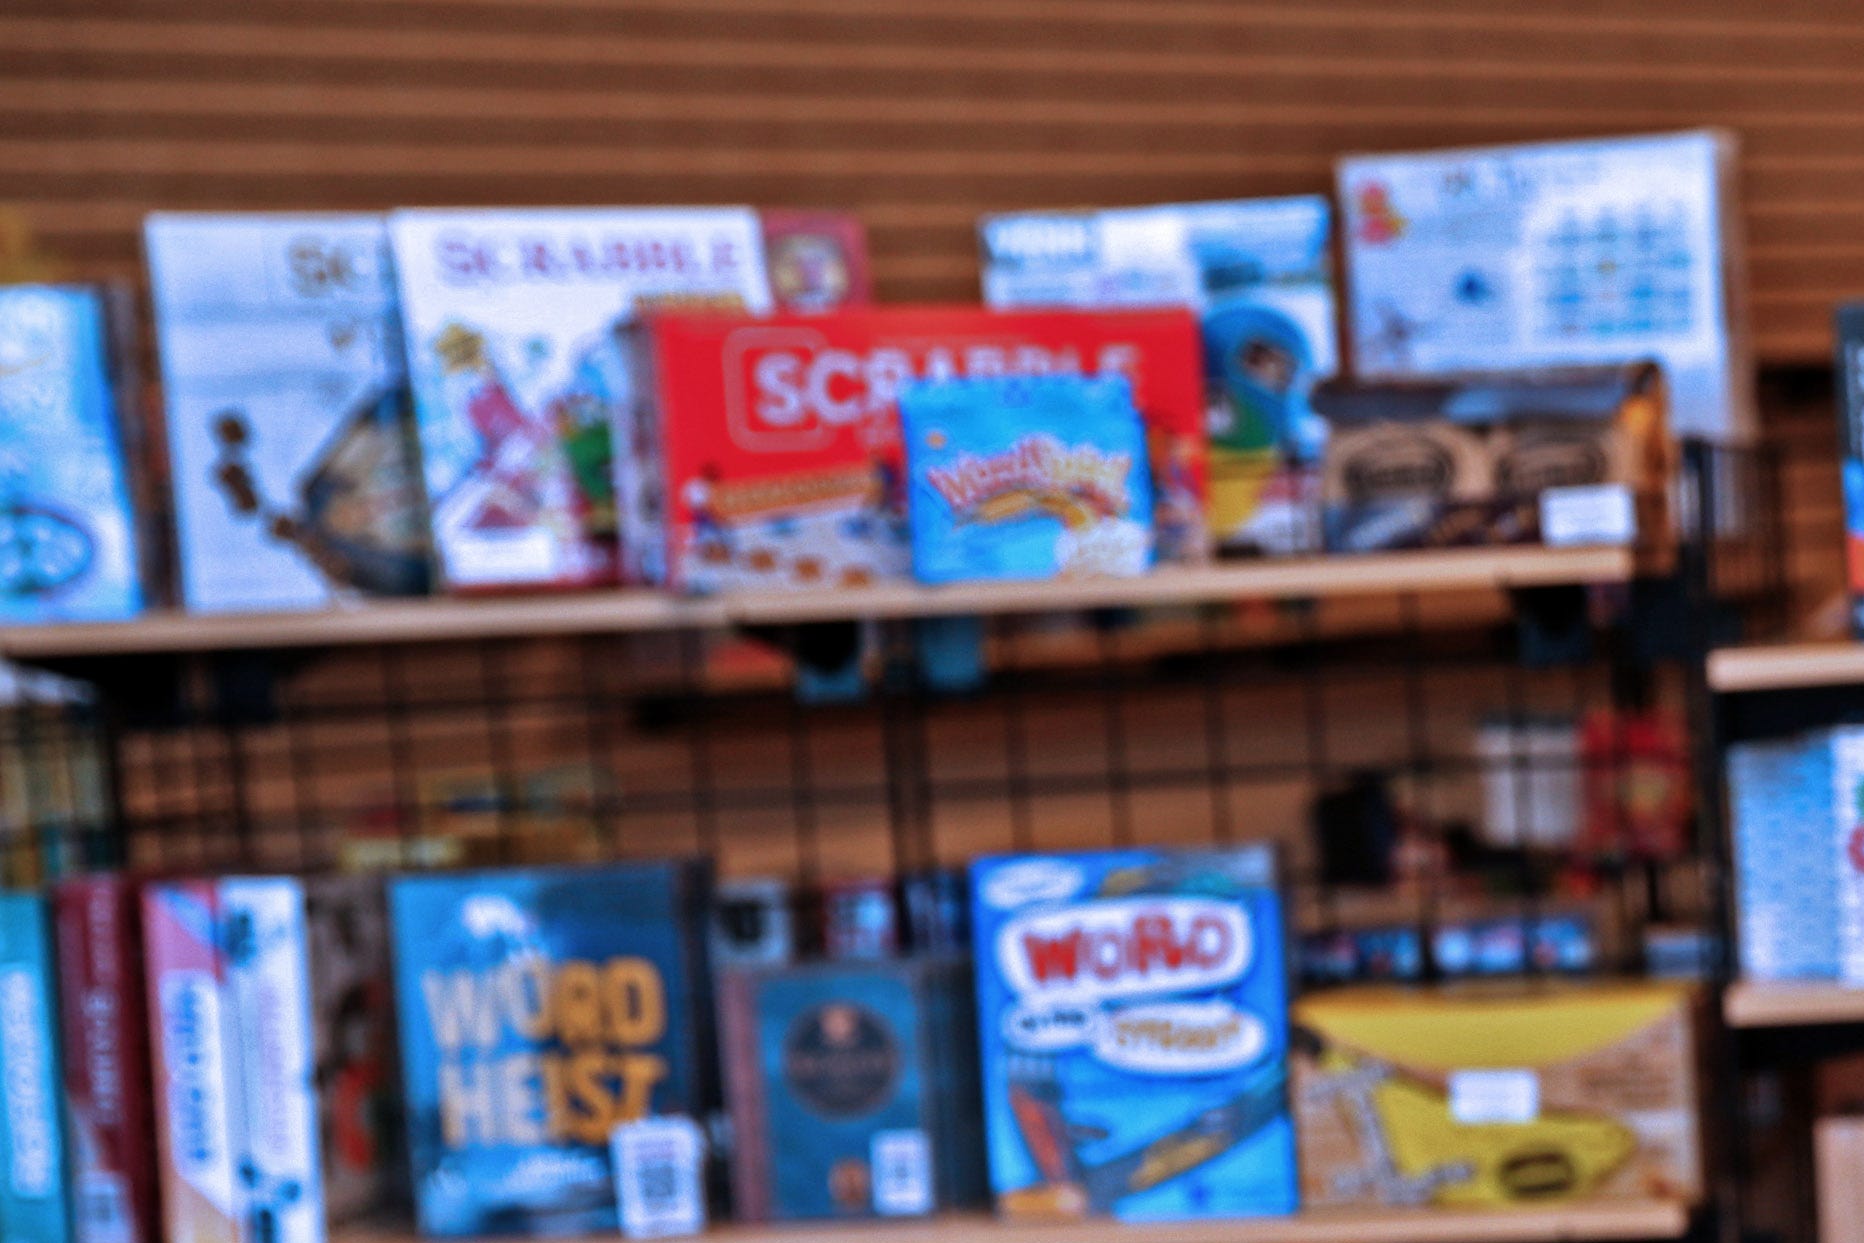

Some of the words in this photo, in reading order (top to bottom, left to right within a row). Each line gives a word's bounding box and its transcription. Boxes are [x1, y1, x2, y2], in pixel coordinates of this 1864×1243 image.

[1023, 910, 1232, 984] WORD
[421, 955, 666, 1050] WORD
[440, 1051, 667, 1151] HEIST
